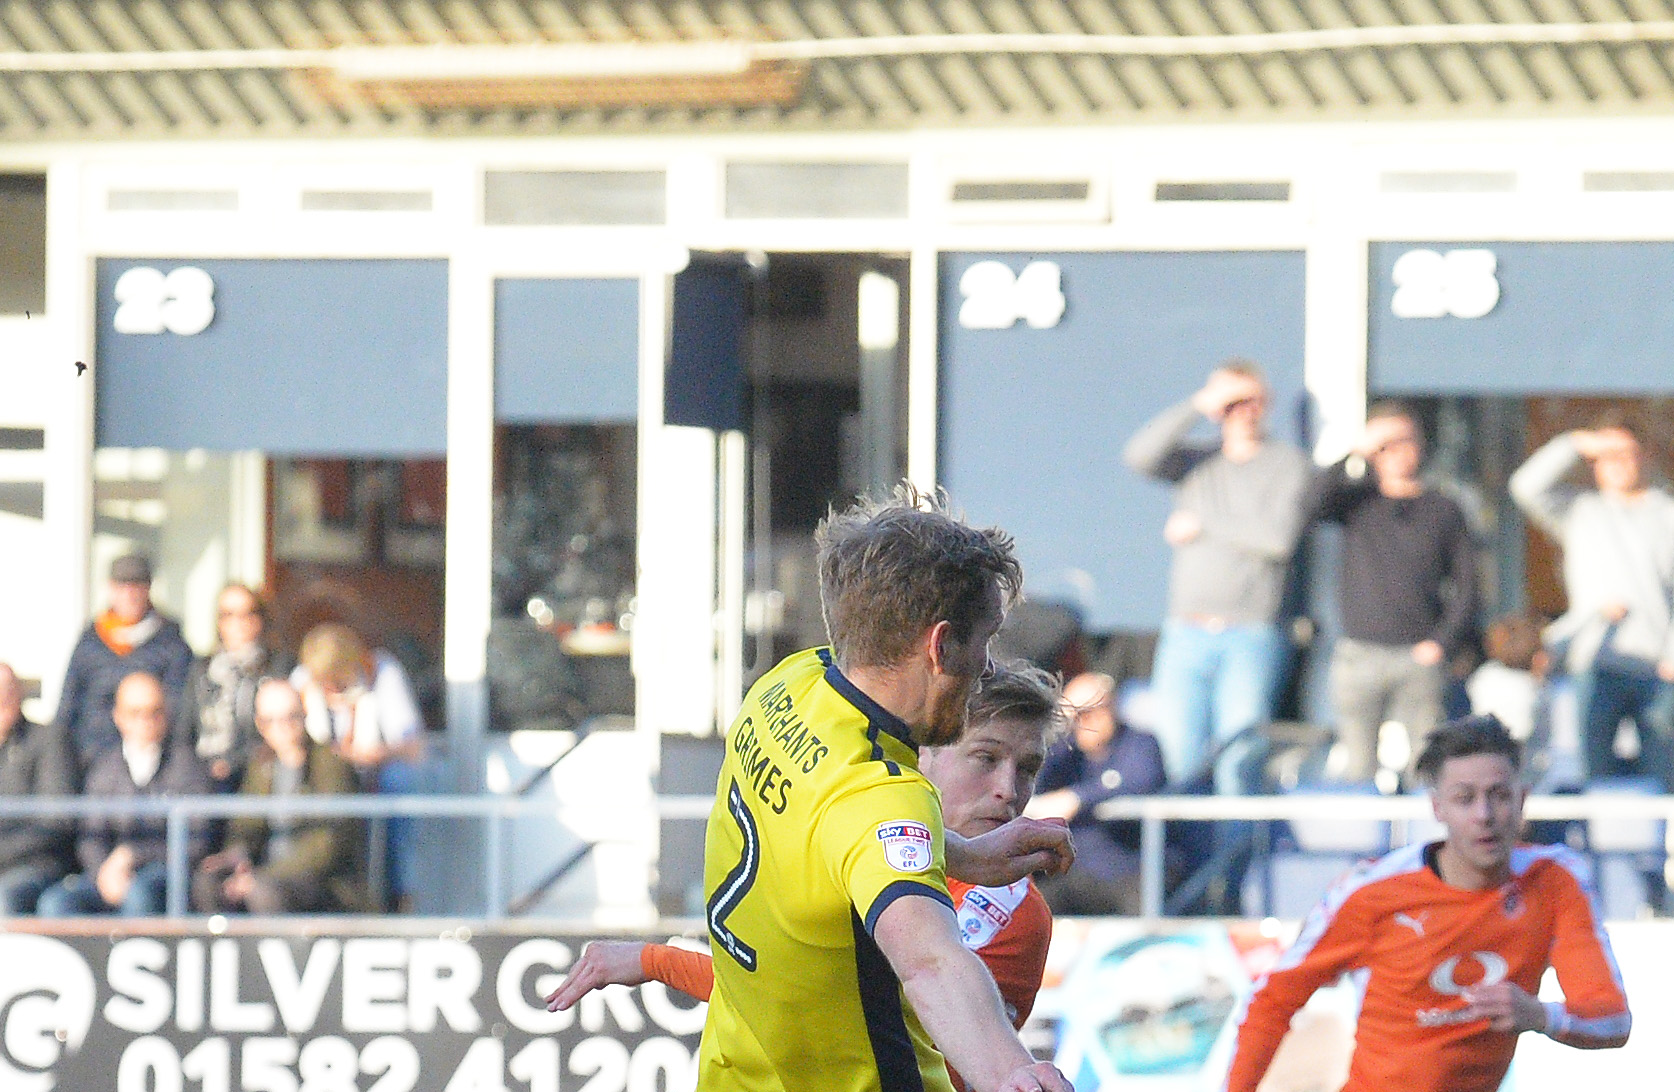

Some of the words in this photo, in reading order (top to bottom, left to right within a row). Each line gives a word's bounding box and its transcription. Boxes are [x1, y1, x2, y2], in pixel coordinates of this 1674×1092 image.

[113, 266, 215, 336] 23
[959, 261, 1066, 329] 24
[707, 775, 758, 972] 2
[103, 937, 482, 1034] SILVER
